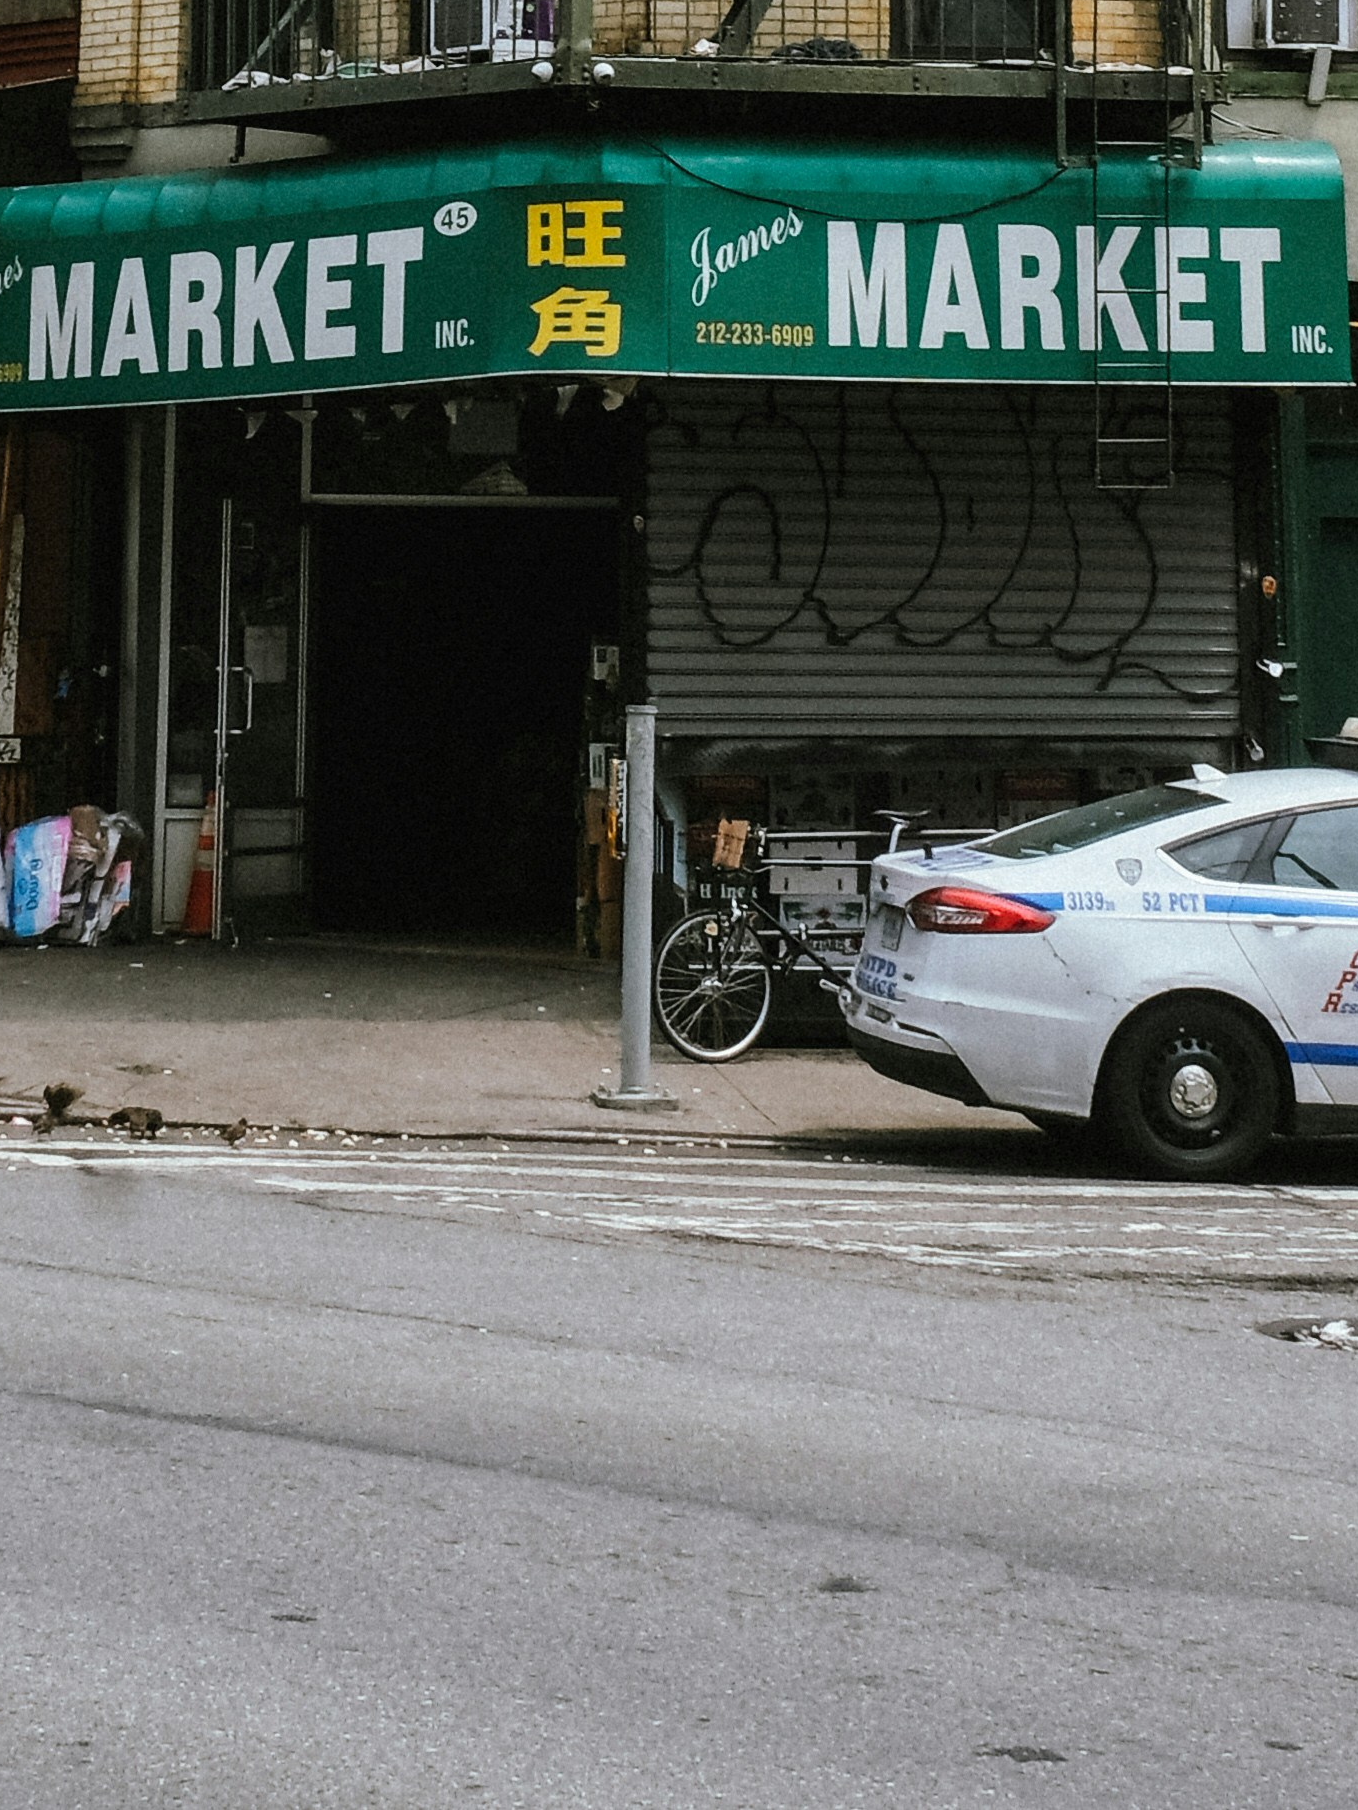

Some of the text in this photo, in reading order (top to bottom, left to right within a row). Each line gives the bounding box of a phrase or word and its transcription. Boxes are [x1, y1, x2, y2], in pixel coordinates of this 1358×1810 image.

[440, 206, 470, 231] 45
[28, 226, 425, 382] MARKET
[434, 318, 476, 351] INC.
[526, 198, 626, 358] 旺角
[690, 206, 1335, 355] James MARKET INC.
[695, 322, 815, 347] 212-233-6909
[1142, 891, 1200, 913] 52 PCT
